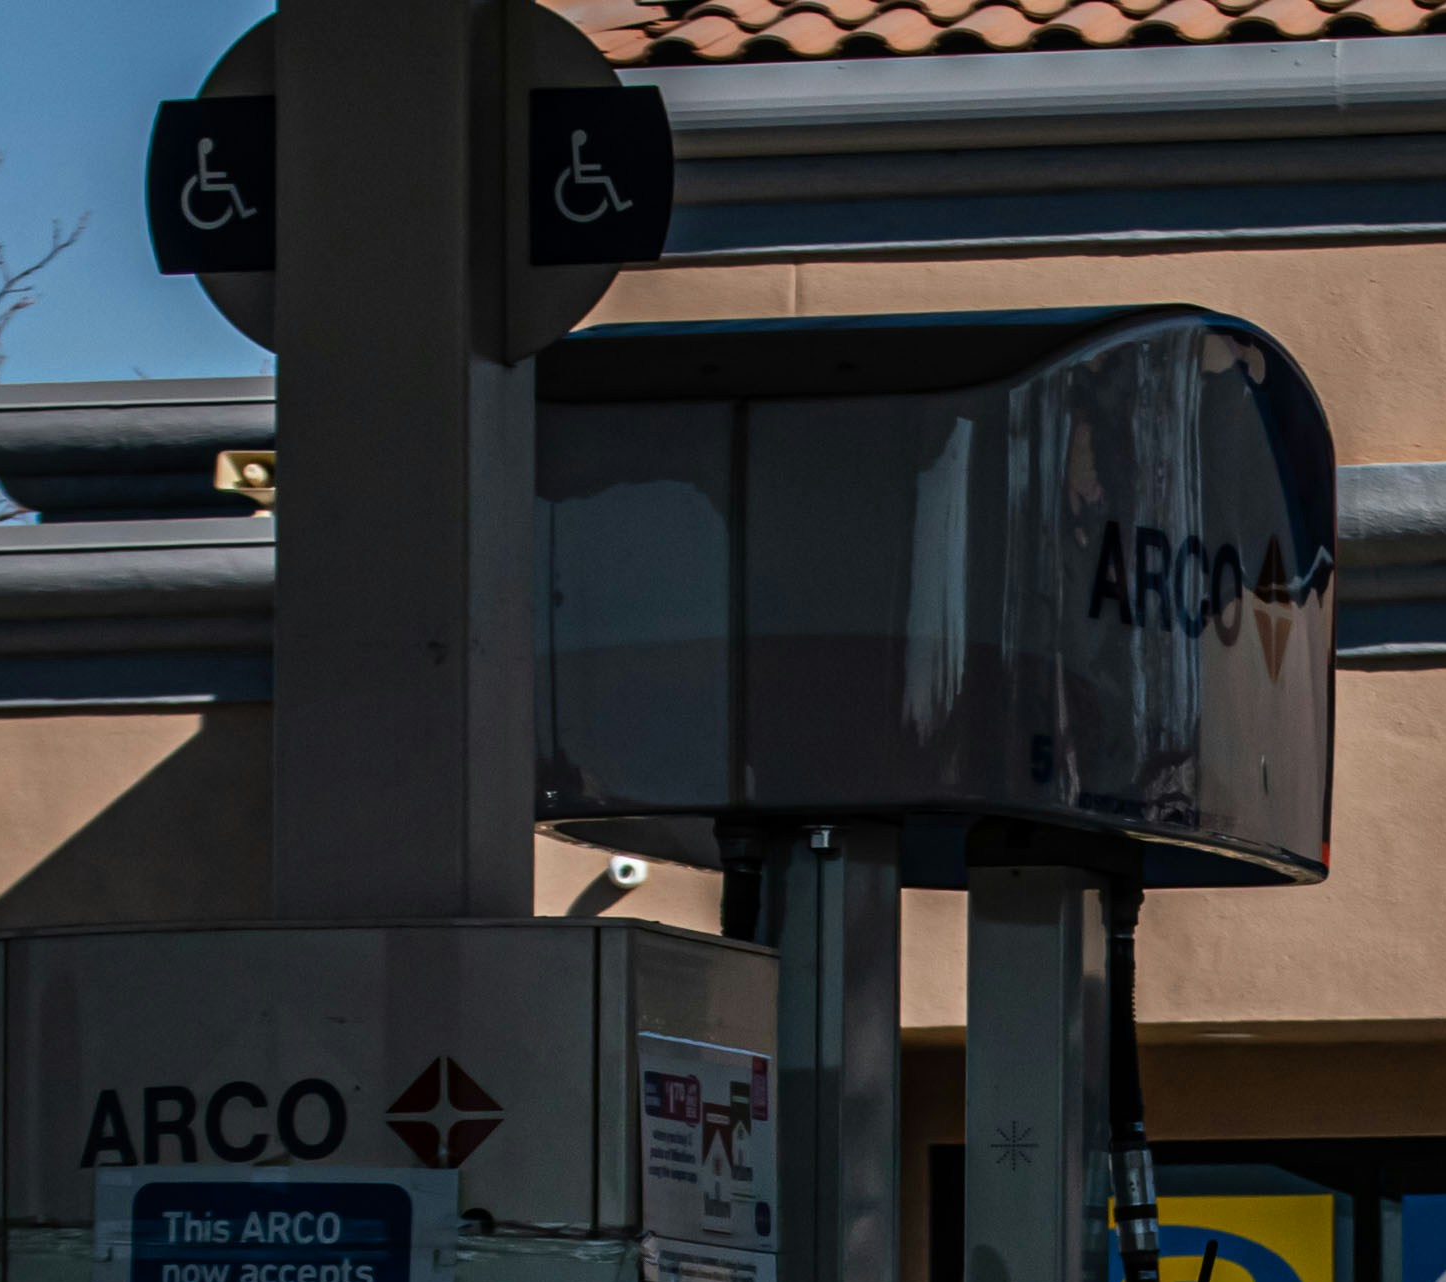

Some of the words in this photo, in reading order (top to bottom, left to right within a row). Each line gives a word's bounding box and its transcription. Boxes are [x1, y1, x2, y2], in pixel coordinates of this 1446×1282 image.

[1088, 520, 1242, 647] ARCO
[1030, 734, 1053, 782] 5
[81, 1078, 346, 1168] ARCO
[161, 1210, 231, 1244] This
[240, 1210, 341, 1244] ARCO
